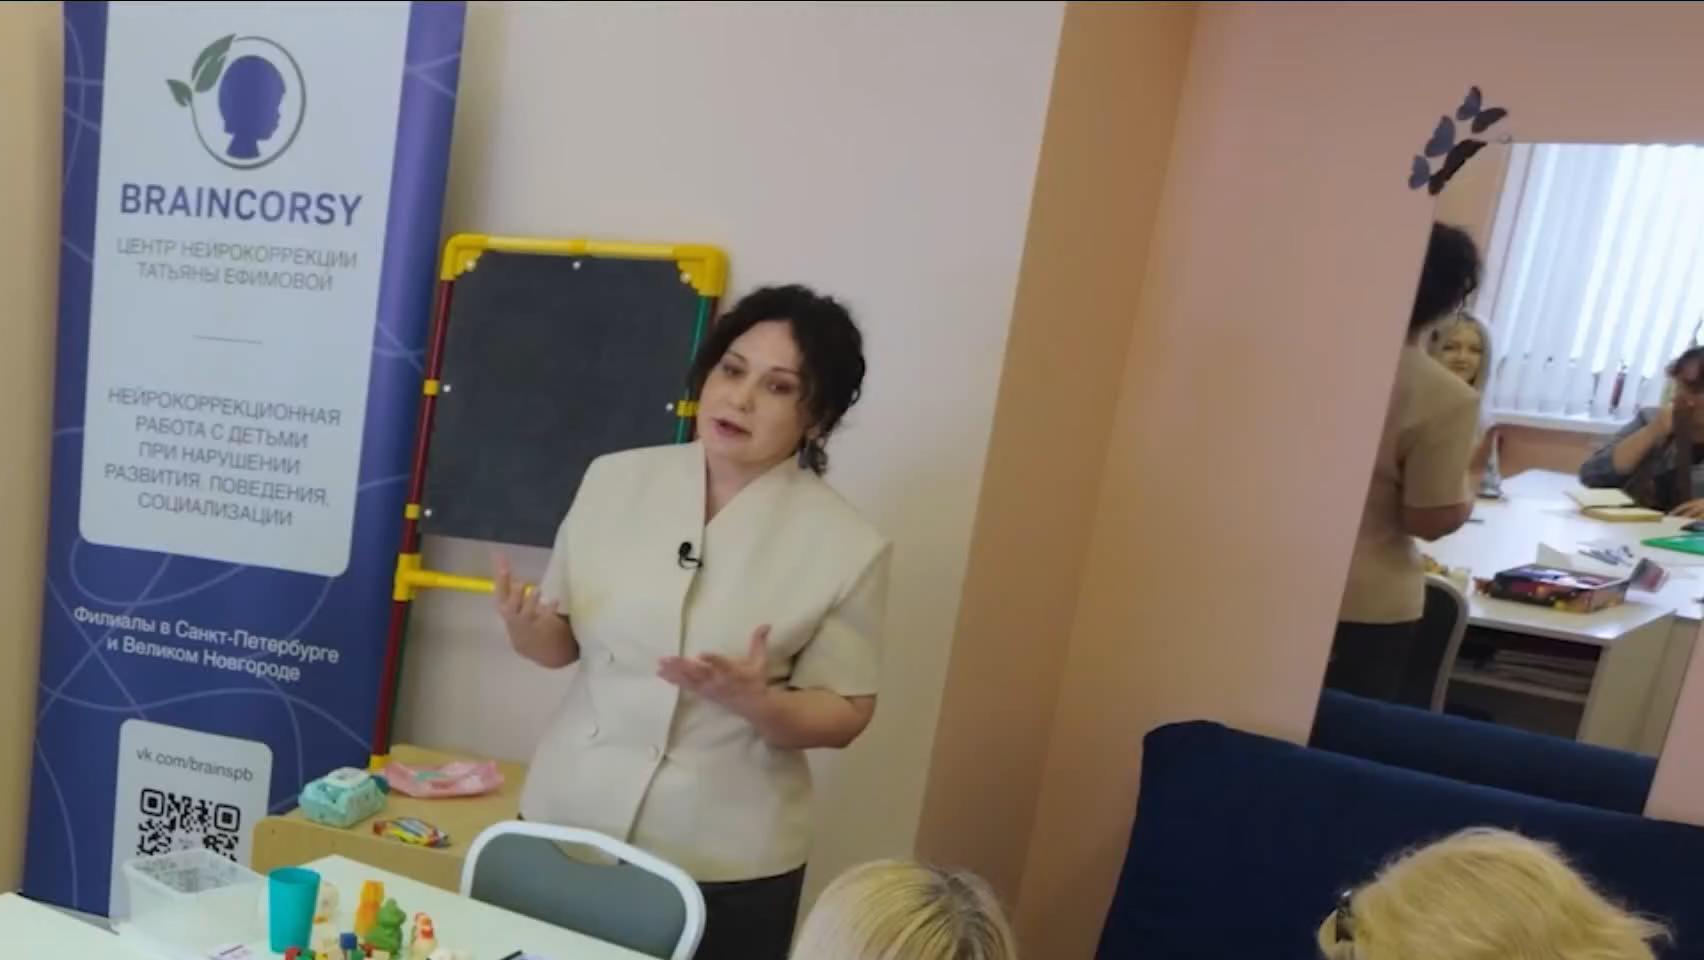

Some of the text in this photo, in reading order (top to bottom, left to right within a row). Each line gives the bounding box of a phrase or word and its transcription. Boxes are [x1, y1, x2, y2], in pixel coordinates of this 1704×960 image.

[120, 183, 363, 226] BRAINCORSY
[116, 237, 357, 269] ЦЕНТР НЕЙРОКОРРЕКЦИИ
[137, 261, 334, 291] ТАТЬЯНЫ ЕФИМОВОЙ
[107, 386, 341, 426] НЕЙРОКОРРЕКЦИОННАЯ
[135, 415, 309, 449] РАБОТА С ДЕТЬМИ
[138, 442, 301, 475] ПРИ НАРУШЕНИИ
[137, 491, 294, 527] СОЦИАЛИЗАЦИИ
[208, 476, 330, 506] ПОВЕДЕНИЯ,
[73, 606, 340, 664] Филиалы в Санкт-Петербурге
[106, 636, 301, 683] и Великом Новгороде
[135, 747, 254, 784] vk.com/brainspb
